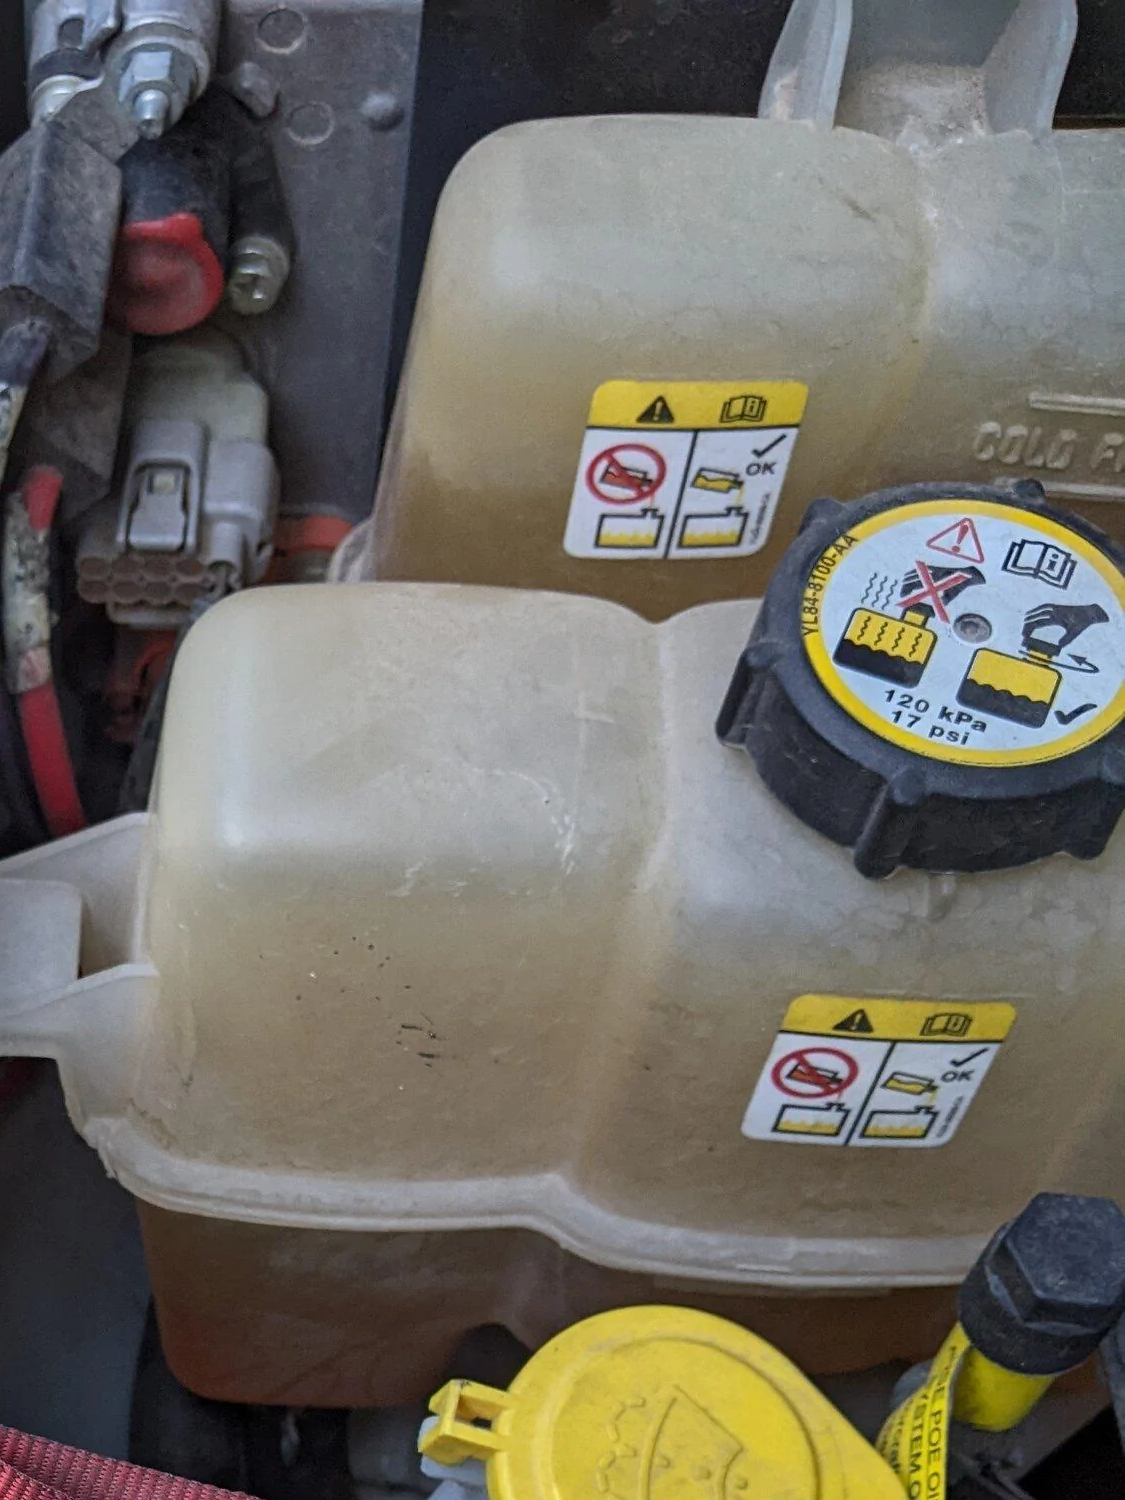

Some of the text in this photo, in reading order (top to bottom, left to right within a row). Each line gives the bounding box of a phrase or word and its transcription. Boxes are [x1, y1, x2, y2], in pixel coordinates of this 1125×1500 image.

[974, 421, 1077, 469] COLD
[746, 463, 777, 476] OK
[802, 535, 858, 636] YL84-8100-AA
[885, 690, 987, 733] 120 kPa
[891, 710, 970, 745] 17 psi
[941, 1070, 975, 1083] OK
[909, 1393, 929, 1474] YSTEM
[927, 1409, 942, 1465] POE
